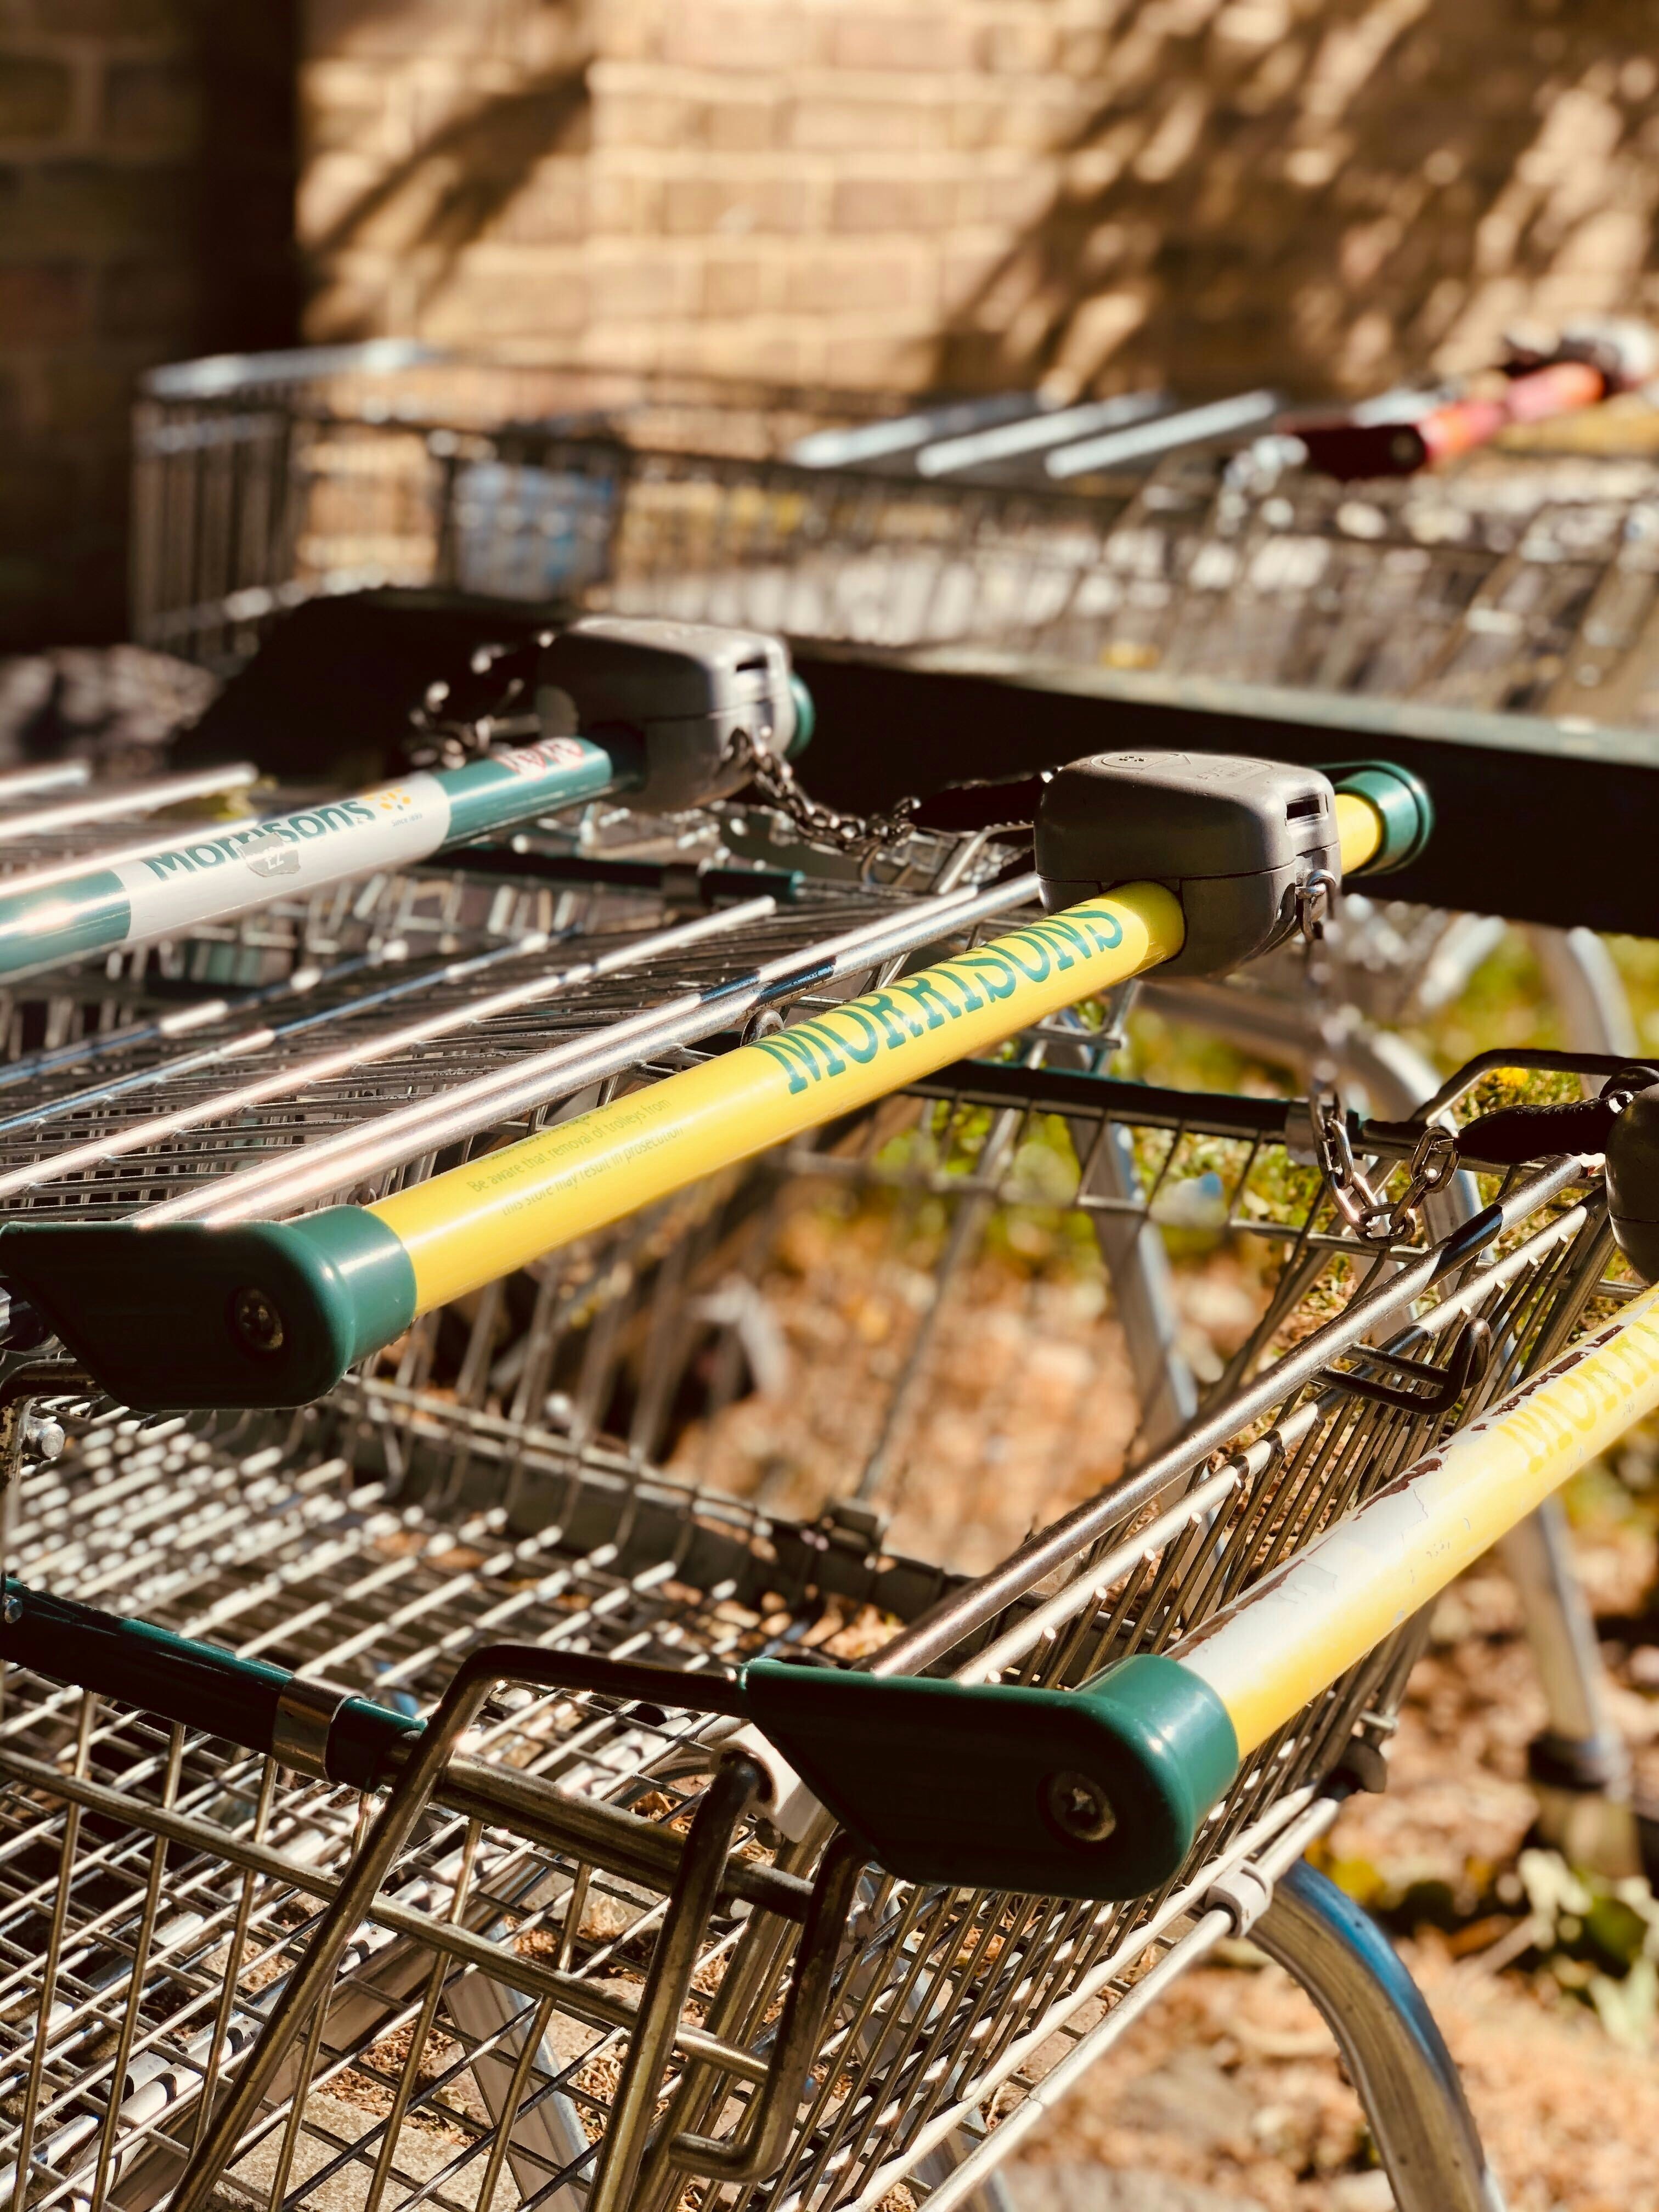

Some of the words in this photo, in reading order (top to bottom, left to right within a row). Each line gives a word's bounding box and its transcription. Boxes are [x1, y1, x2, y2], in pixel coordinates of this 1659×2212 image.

[391, 816, 408, 827] Since
[746, 904, 1122, 1094] MORRISONS
[466, 1180, 489, 1192] Be
[487, 1164, 525, 1184] aware
[522, 1152, 550, 1169] that
[548, 1132, 594, 1159] removal
[592, 1125, 607, 1138] of
[604, 1110, 646, 1132] trolleys
[641, 1099, 672, 1115] from
[623, 1127, 684, 1164] prosecution
